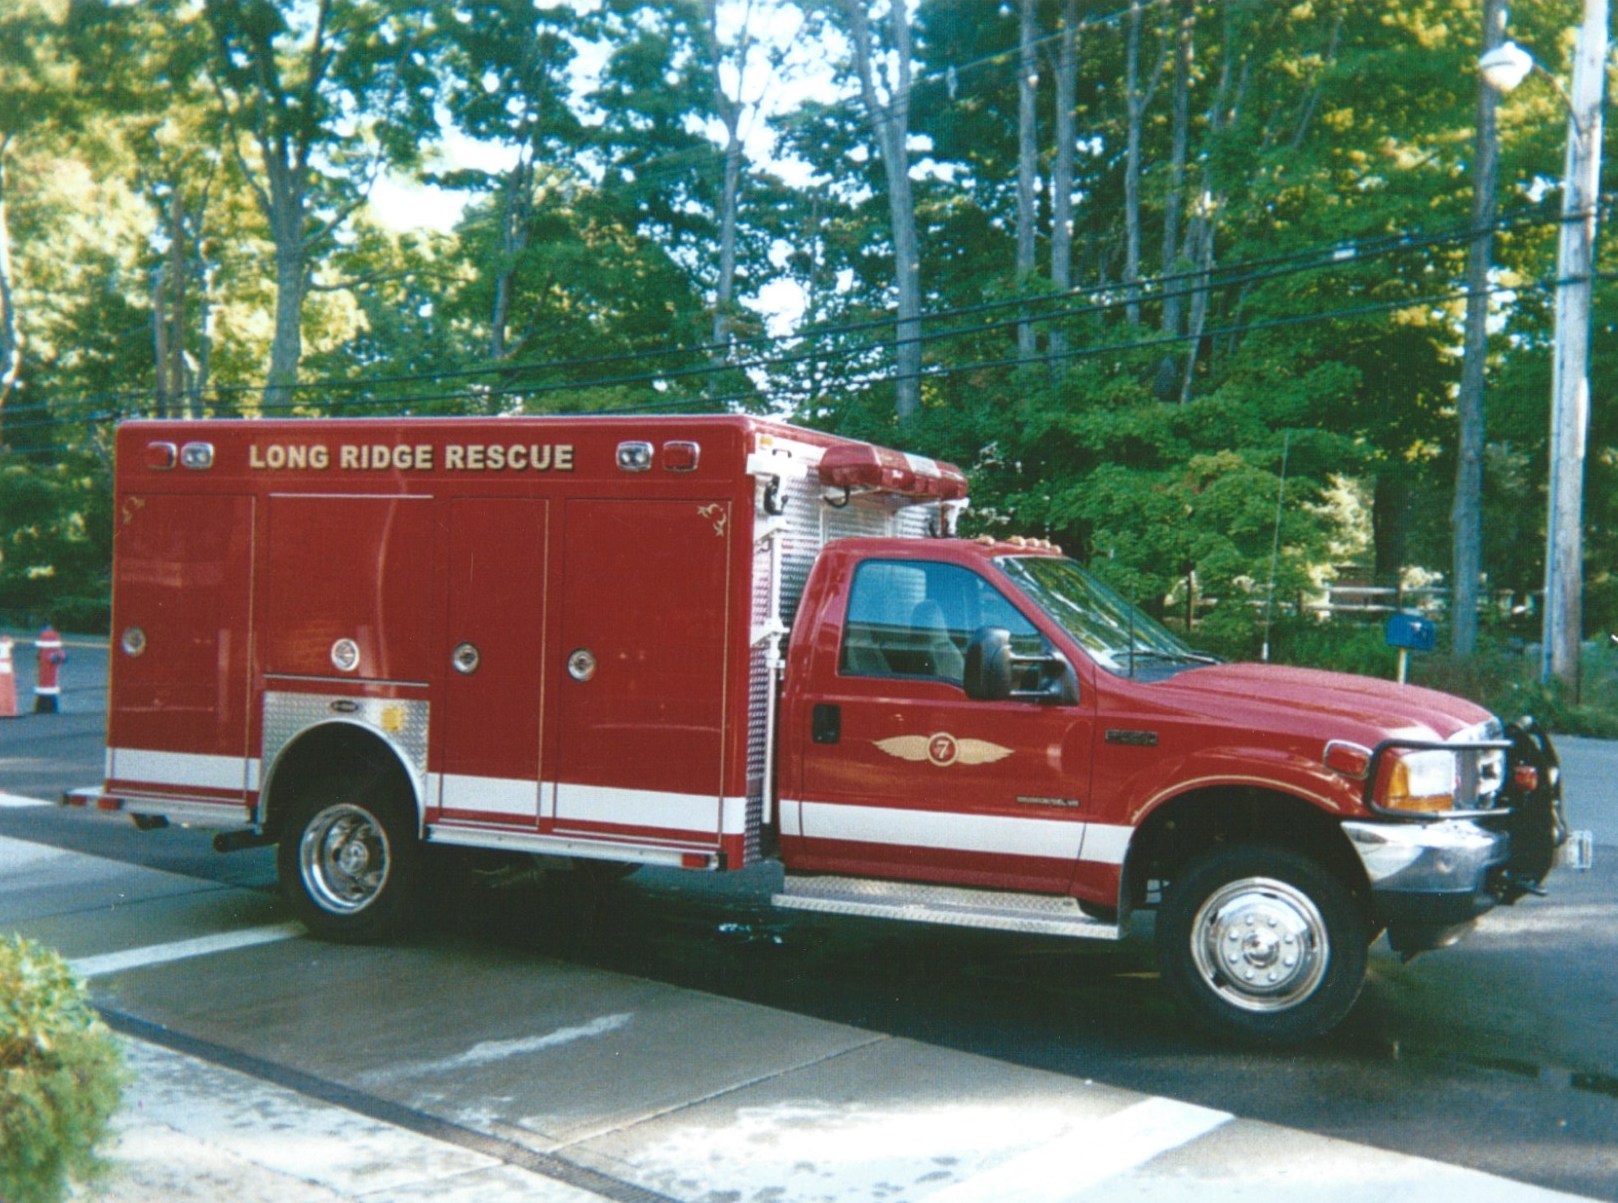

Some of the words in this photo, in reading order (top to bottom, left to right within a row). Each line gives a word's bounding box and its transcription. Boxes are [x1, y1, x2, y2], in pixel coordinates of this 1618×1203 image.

[249, 445, 329, 469] LONG
[340, 445, 433, 469] RIDGE
[445, 445, 574, 470] RESCUE
[936, 740, 950, 759] 7
